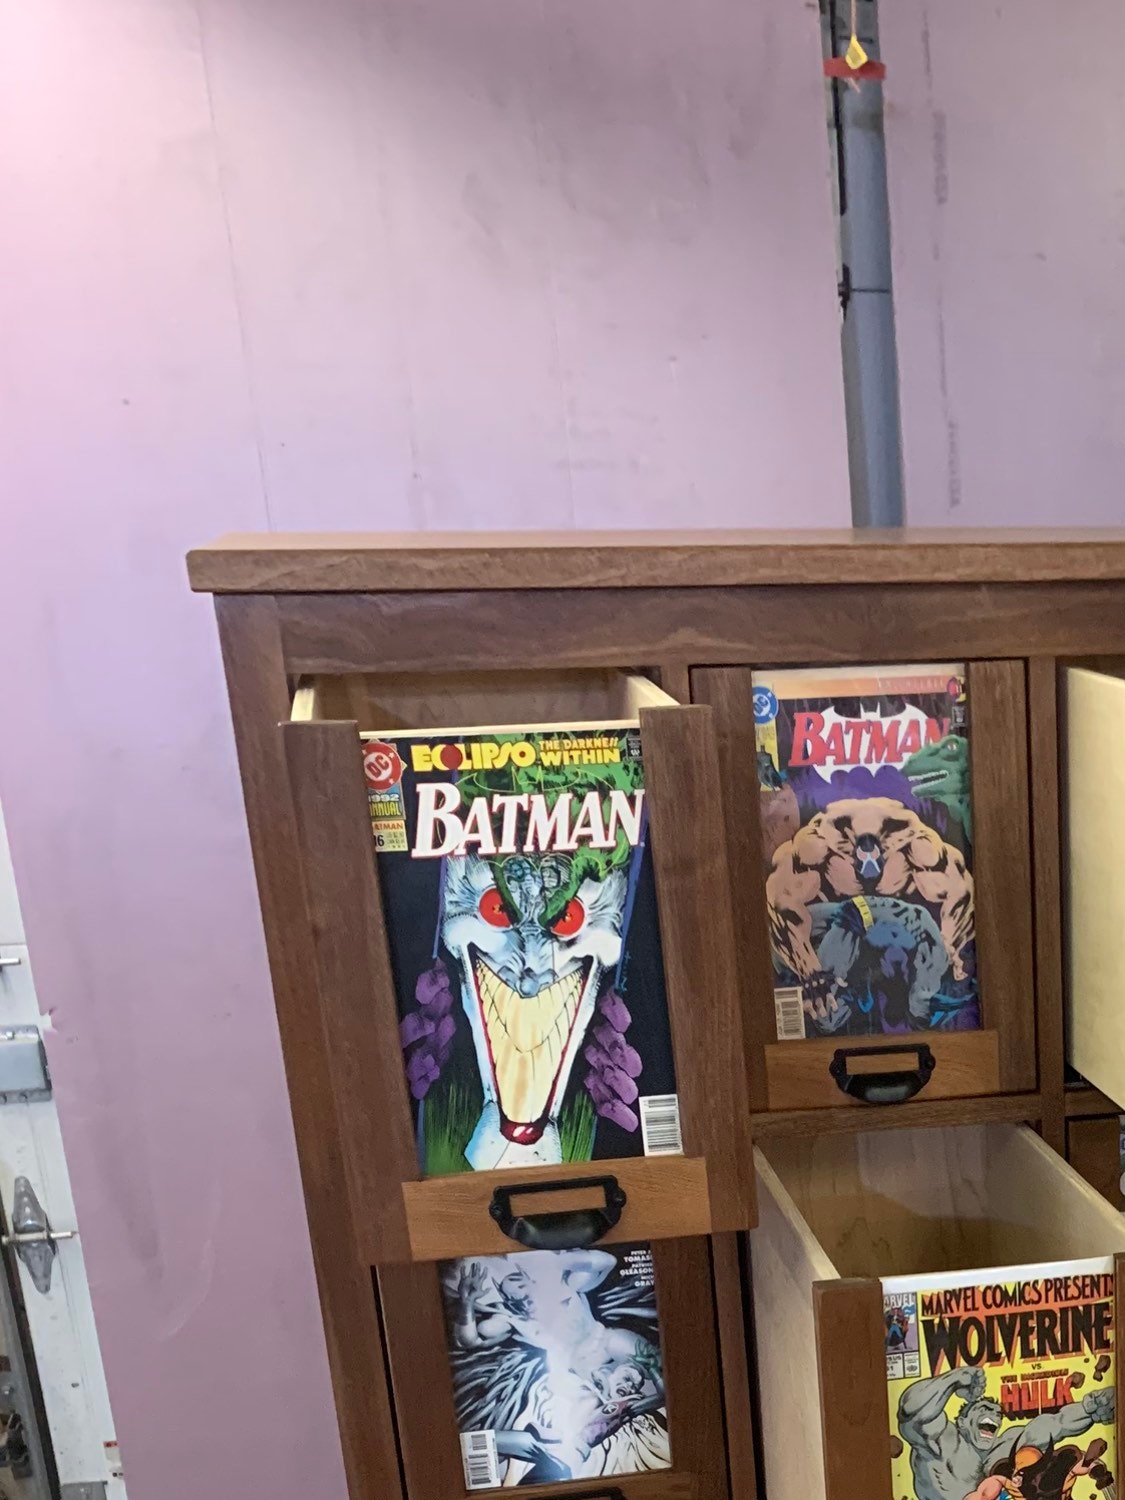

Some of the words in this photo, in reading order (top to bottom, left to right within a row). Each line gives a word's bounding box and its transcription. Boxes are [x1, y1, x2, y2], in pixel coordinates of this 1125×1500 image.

[539, 739, 560, 750] THE
[788, 712, 951, 767] BATMAN
[366, 754, 389, 779] DC
[540, 748, 621, 767] WITHIN
[373, 822, 404, 831] ATMAN
[411, 782, 645, 858] BATMAN
[884, 1293, 914, 1307] ARVEL
[921, 1286, 979, 1316] MARVEL
[982, 1280, 1042, 1309] COMICS
[921, 1302, 1114, 1376] WOLVERINE
[1001, 1377, 1073, 1412] HULK
